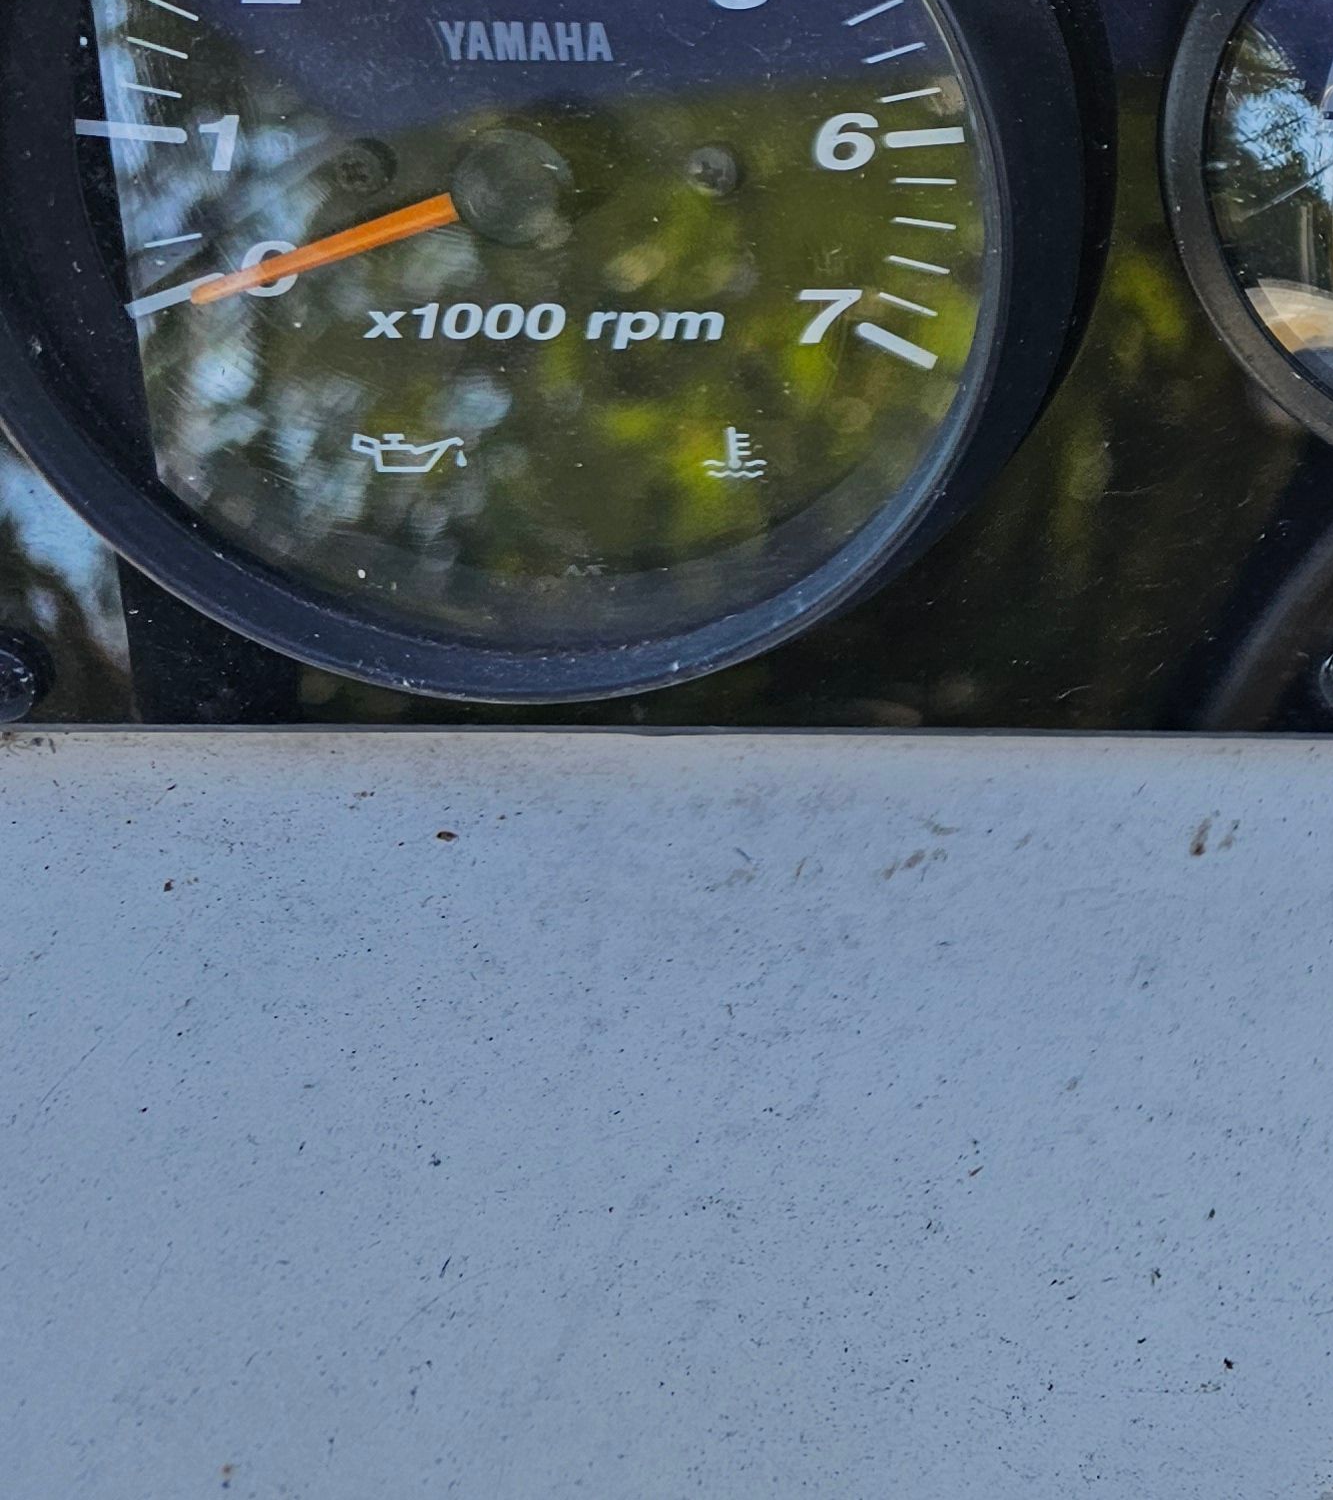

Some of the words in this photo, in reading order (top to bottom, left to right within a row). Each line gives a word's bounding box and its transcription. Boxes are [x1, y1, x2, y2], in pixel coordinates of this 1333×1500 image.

[440, 21, 613, 62] YAMAHA
[199, 114, 240, 171] 1
[814, 113, 878, 170] 6
[241, 240, 303, 298] 0
[363, 303, 564, 340] x1000
[585, 309, 725, 349] rpm
[797, 290, 861, 344] 7
